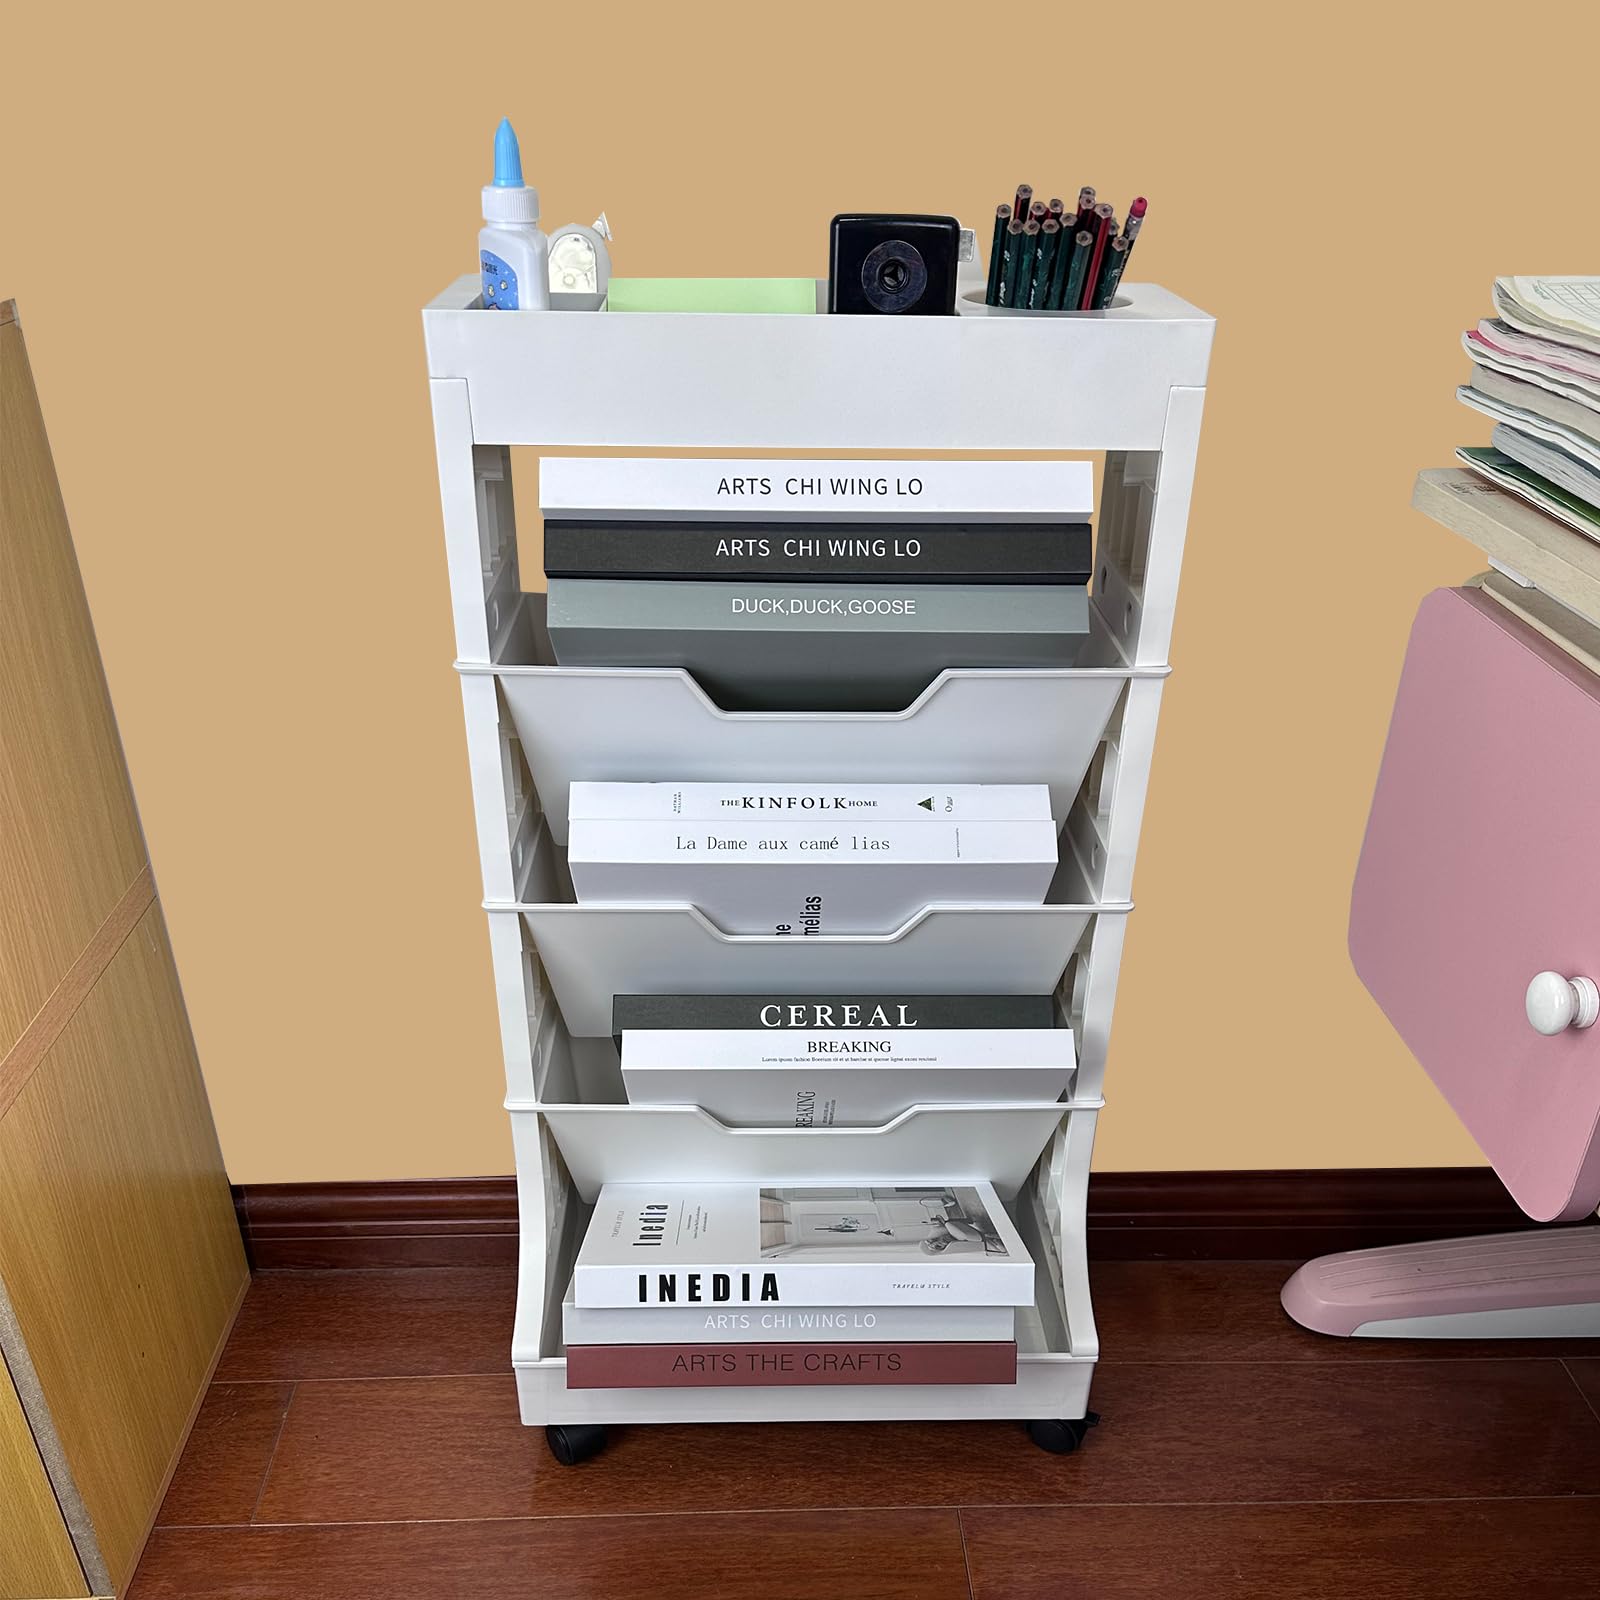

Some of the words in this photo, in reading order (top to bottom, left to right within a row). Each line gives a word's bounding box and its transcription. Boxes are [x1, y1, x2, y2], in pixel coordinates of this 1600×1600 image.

[717, 478, 772, 495] ARTS
[785, 478, 822, 495] CHI
[830, 478, 888, 495] WING
[897, 478, 923, 495] LO
[715, 539, 770, 556] ARTS
[783, 539, 820, 556] CHI
[828, 539, 886, 557] WING
[895, 539, 921, 556] LO
[741, 797, 847, 809] KINFOLK
[677, 837, 696, 850] La
[707, 837, 748, 850] Dame
[758, 840, 788, 850] aux
[799, 836, 839, 850] camé
[852, 836, 890, 850] lias
[760, 1004, 918, 1028] CEREAL
[807, 1041, 892, 1053] BREAKING
[632, 1204, 669, 1246] Inedia
[638, 1273, 780, 1302] INEDIA
[704, 1314, 750, 1329] ARTS
[761, 1314, 792, 1329] CHI
[799, 1314, 847, 1328] WING
[853, 1313, 876, 1328] LO
[671, 1354, 737, 1372] ARTS
[746, 1354, 794, 1371] THE
[804, 1353, 902, 1372] CRAFTS
